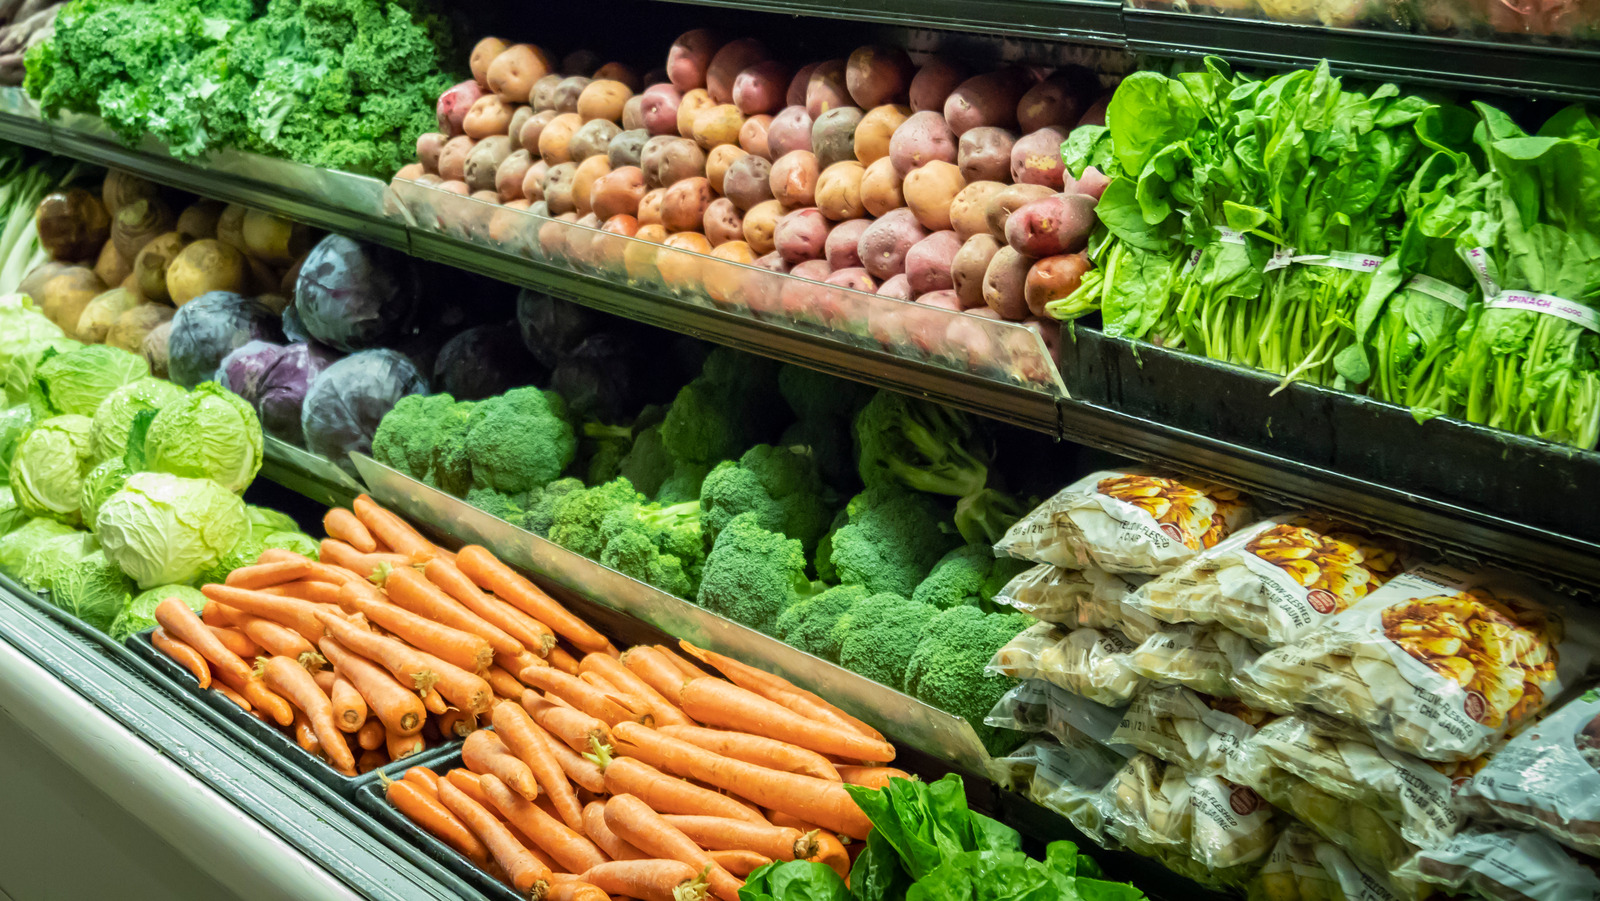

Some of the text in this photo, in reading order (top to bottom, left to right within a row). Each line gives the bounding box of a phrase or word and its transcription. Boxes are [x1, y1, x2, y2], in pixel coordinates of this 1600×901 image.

[1507, 295, 1552, 308] SPINACH
[1032, 524, 1037, 534] 2
[1280, 603, 1304, 630] JAUNE
